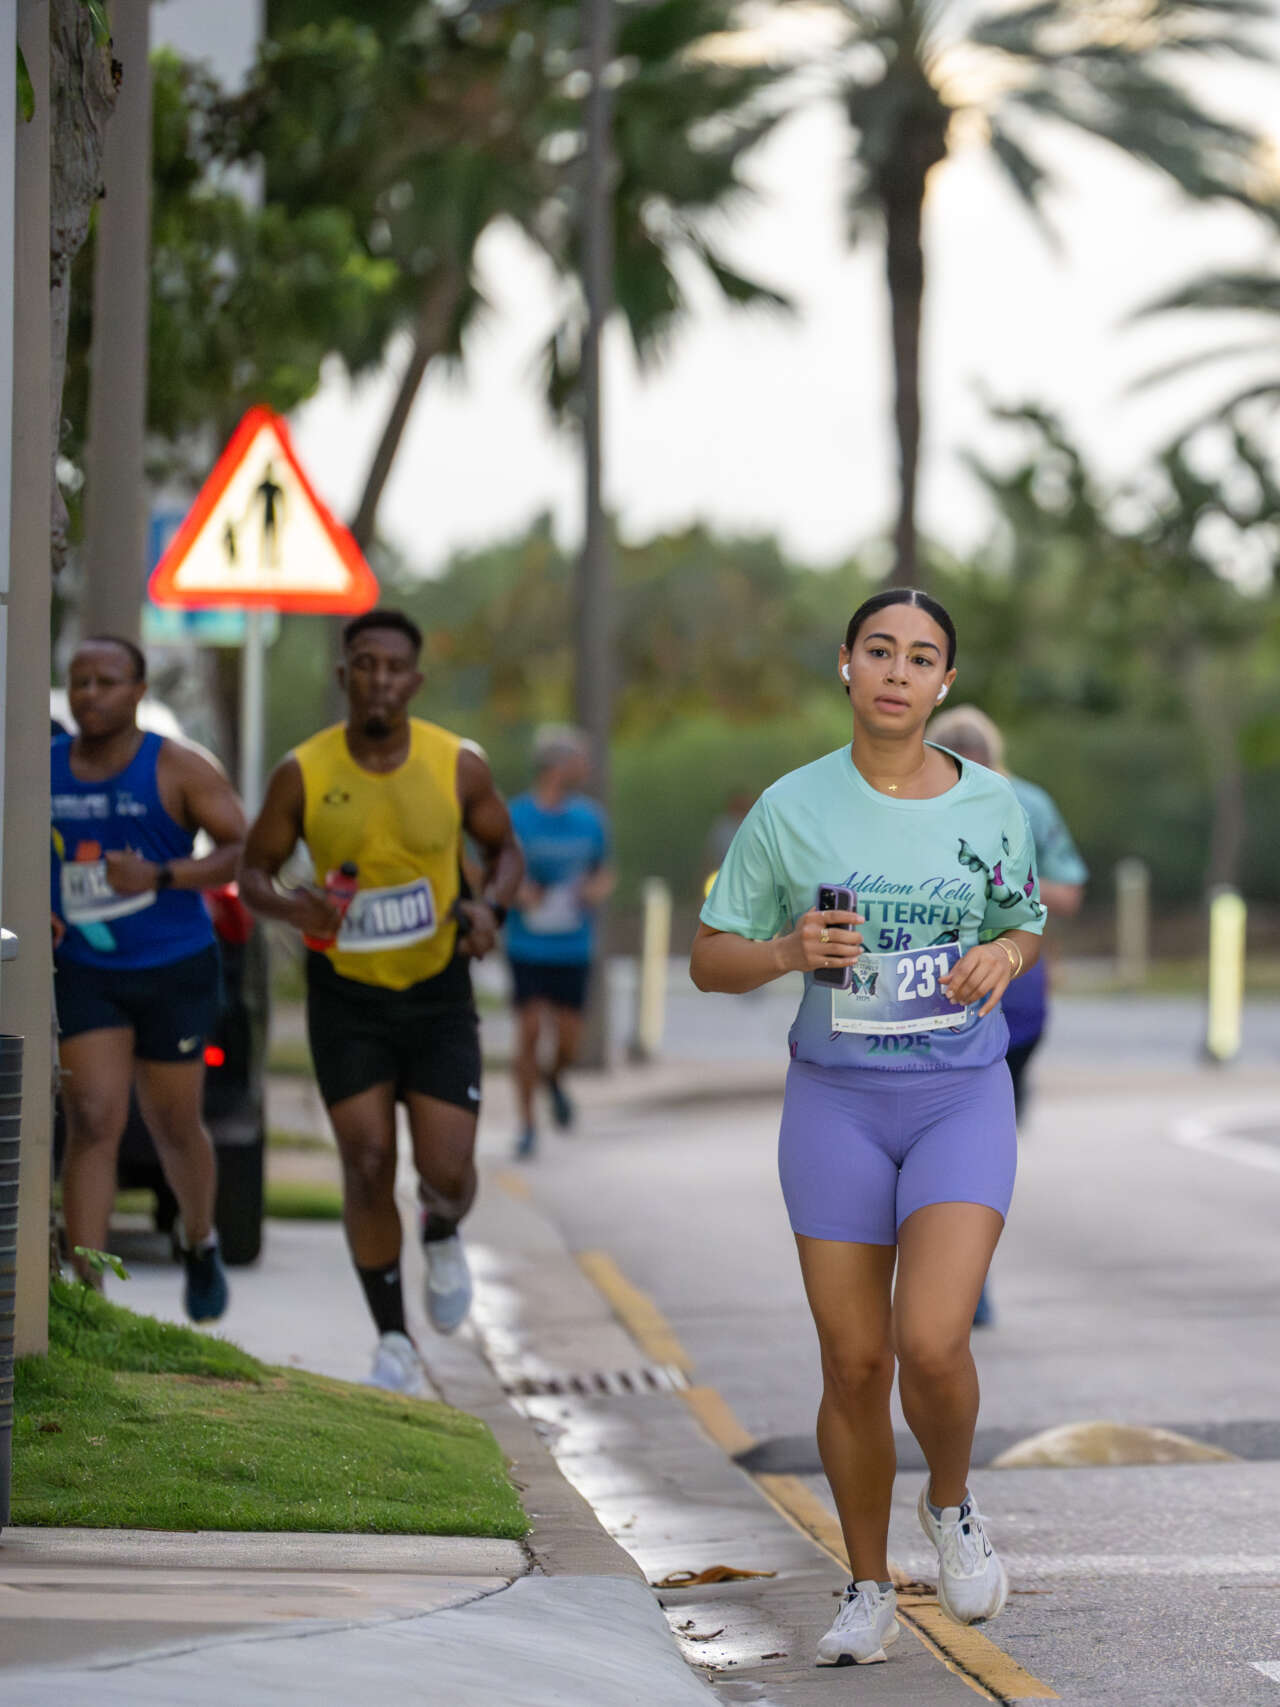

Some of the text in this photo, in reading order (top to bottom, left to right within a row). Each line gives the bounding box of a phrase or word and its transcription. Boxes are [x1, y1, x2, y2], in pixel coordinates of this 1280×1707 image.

[838, 871, 976, 910] Addison Kelly
[373, 891, 428, 933] 1001
[859, 900, 970, 926] TTERFLY
[877, 927, 912, 951] 5k
[896, 952, 950, 1002] 231
[865, 1034, 931, 1057] 2025
